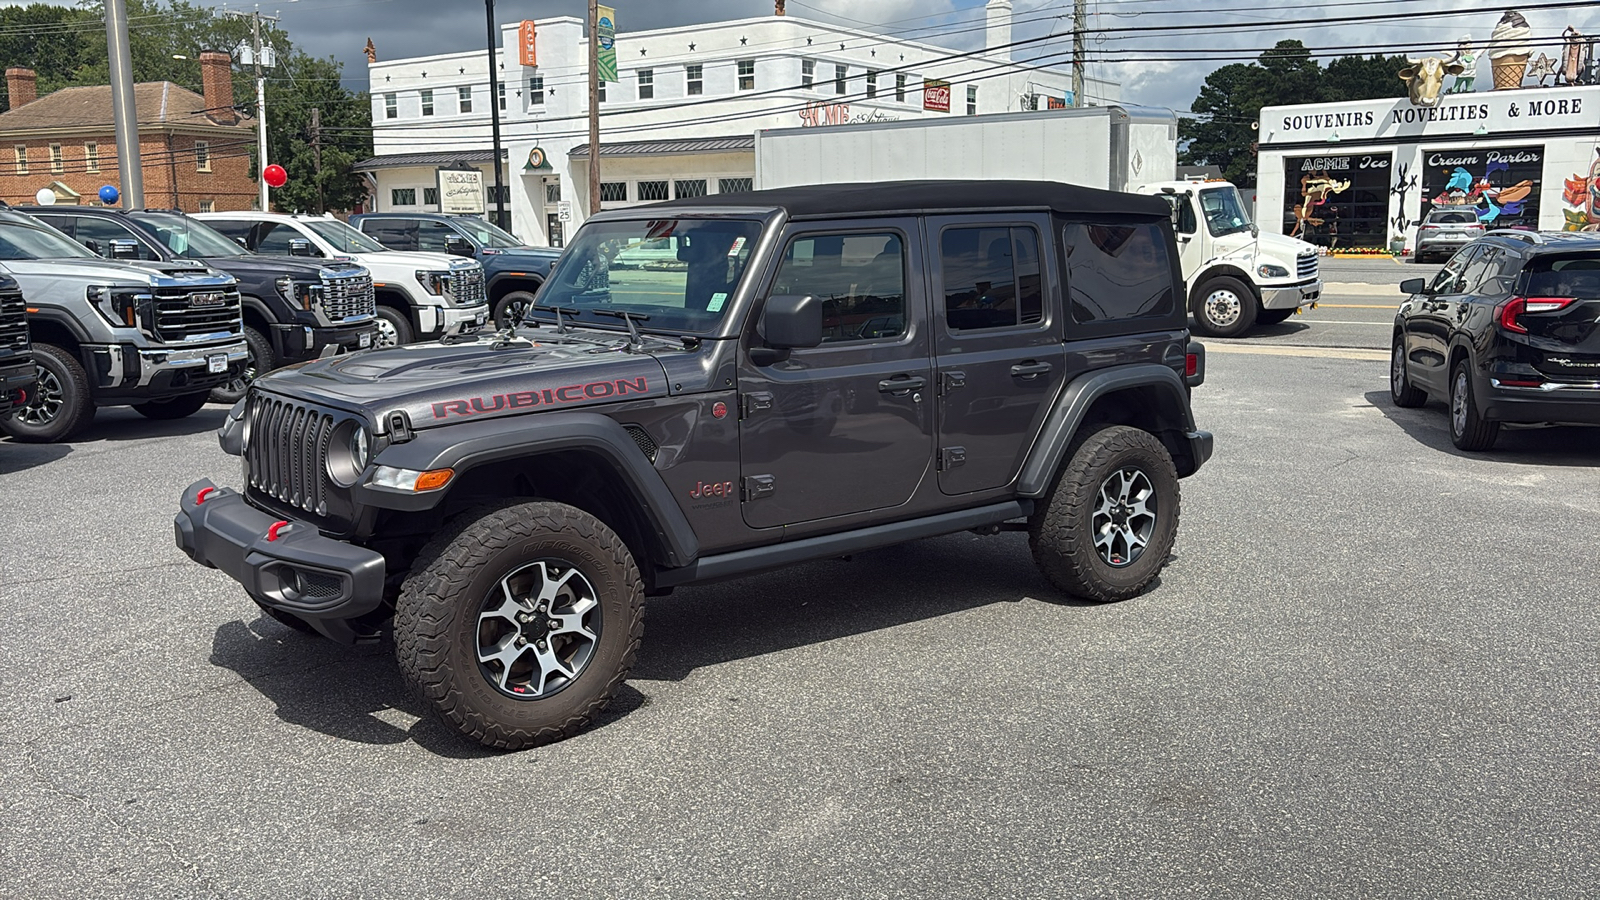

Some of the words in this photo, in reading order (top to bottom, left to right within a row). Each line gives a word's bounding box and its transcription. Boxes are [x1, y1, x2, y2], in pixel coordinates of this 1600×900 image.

[526, 23, 534, 62] ACME
[1283, 111, 1374, 131] SOUVENIRS
[1392, 104, 1489, 124] NOVELTIES
[1508, 102, 1520, 118] &
[1528, 98, 1582, 116] MORE
[1301, 157, 1350, 171] ACME
[1359, 155, 1389, 169] Ice
[1428, 153, 1478, 167] Cream
[1486, 151, 1540, 165] Parlor
[559, 212, 570, 220] 25
[193, 294, 224, 305] GMC
[431, 376, 649, 419] RUBICON
[690, 481, 734, 499] Jeep
